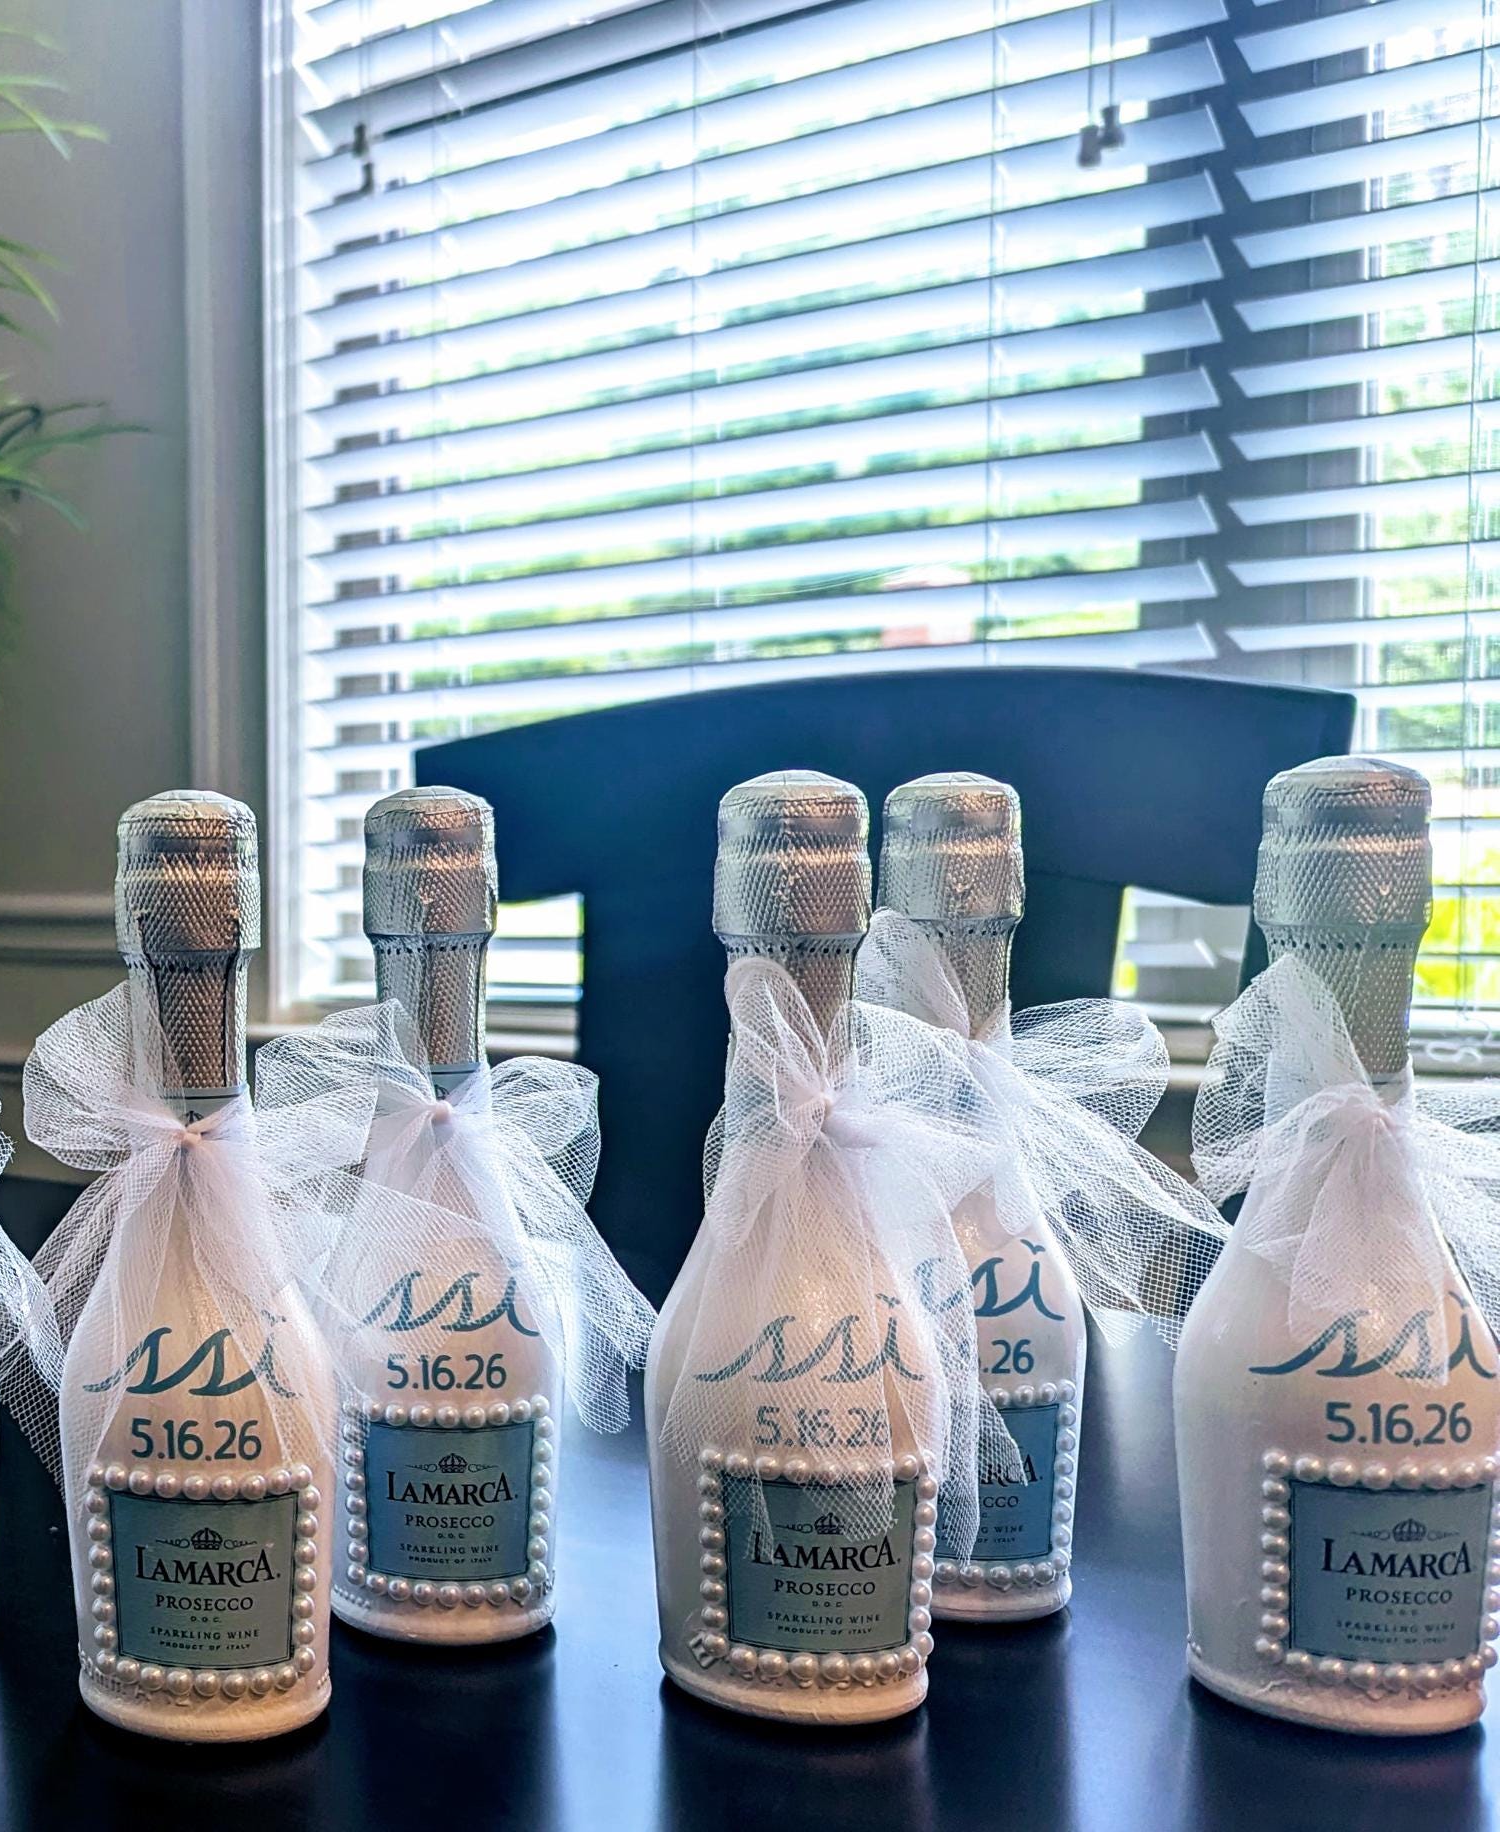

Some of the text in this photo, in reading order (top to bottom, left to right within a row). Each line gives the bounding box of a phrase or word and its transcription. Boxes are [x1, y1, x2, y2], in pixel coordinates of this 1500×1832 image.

[387, 1353, 507, 1390] 5.16.26
[1326, 1402, 1472, 1447] 5.16.26
[131, 1418, 262, 1461] 5.16.26
[405, 1514, 495, 1528] PROSECCO
[399, 1543, 499, 1554] SPARKLING WINE
[774, 1579, 876, 1596] PROSECCO
[156, 1595, 253, 1611] PROSECCO
[1347, 1587, 1453, 1605] PROSECCO
[767, 1612, 880, 1624] SPARKLING WINE
[150, 1626, 221, 1640] SPARKLING
